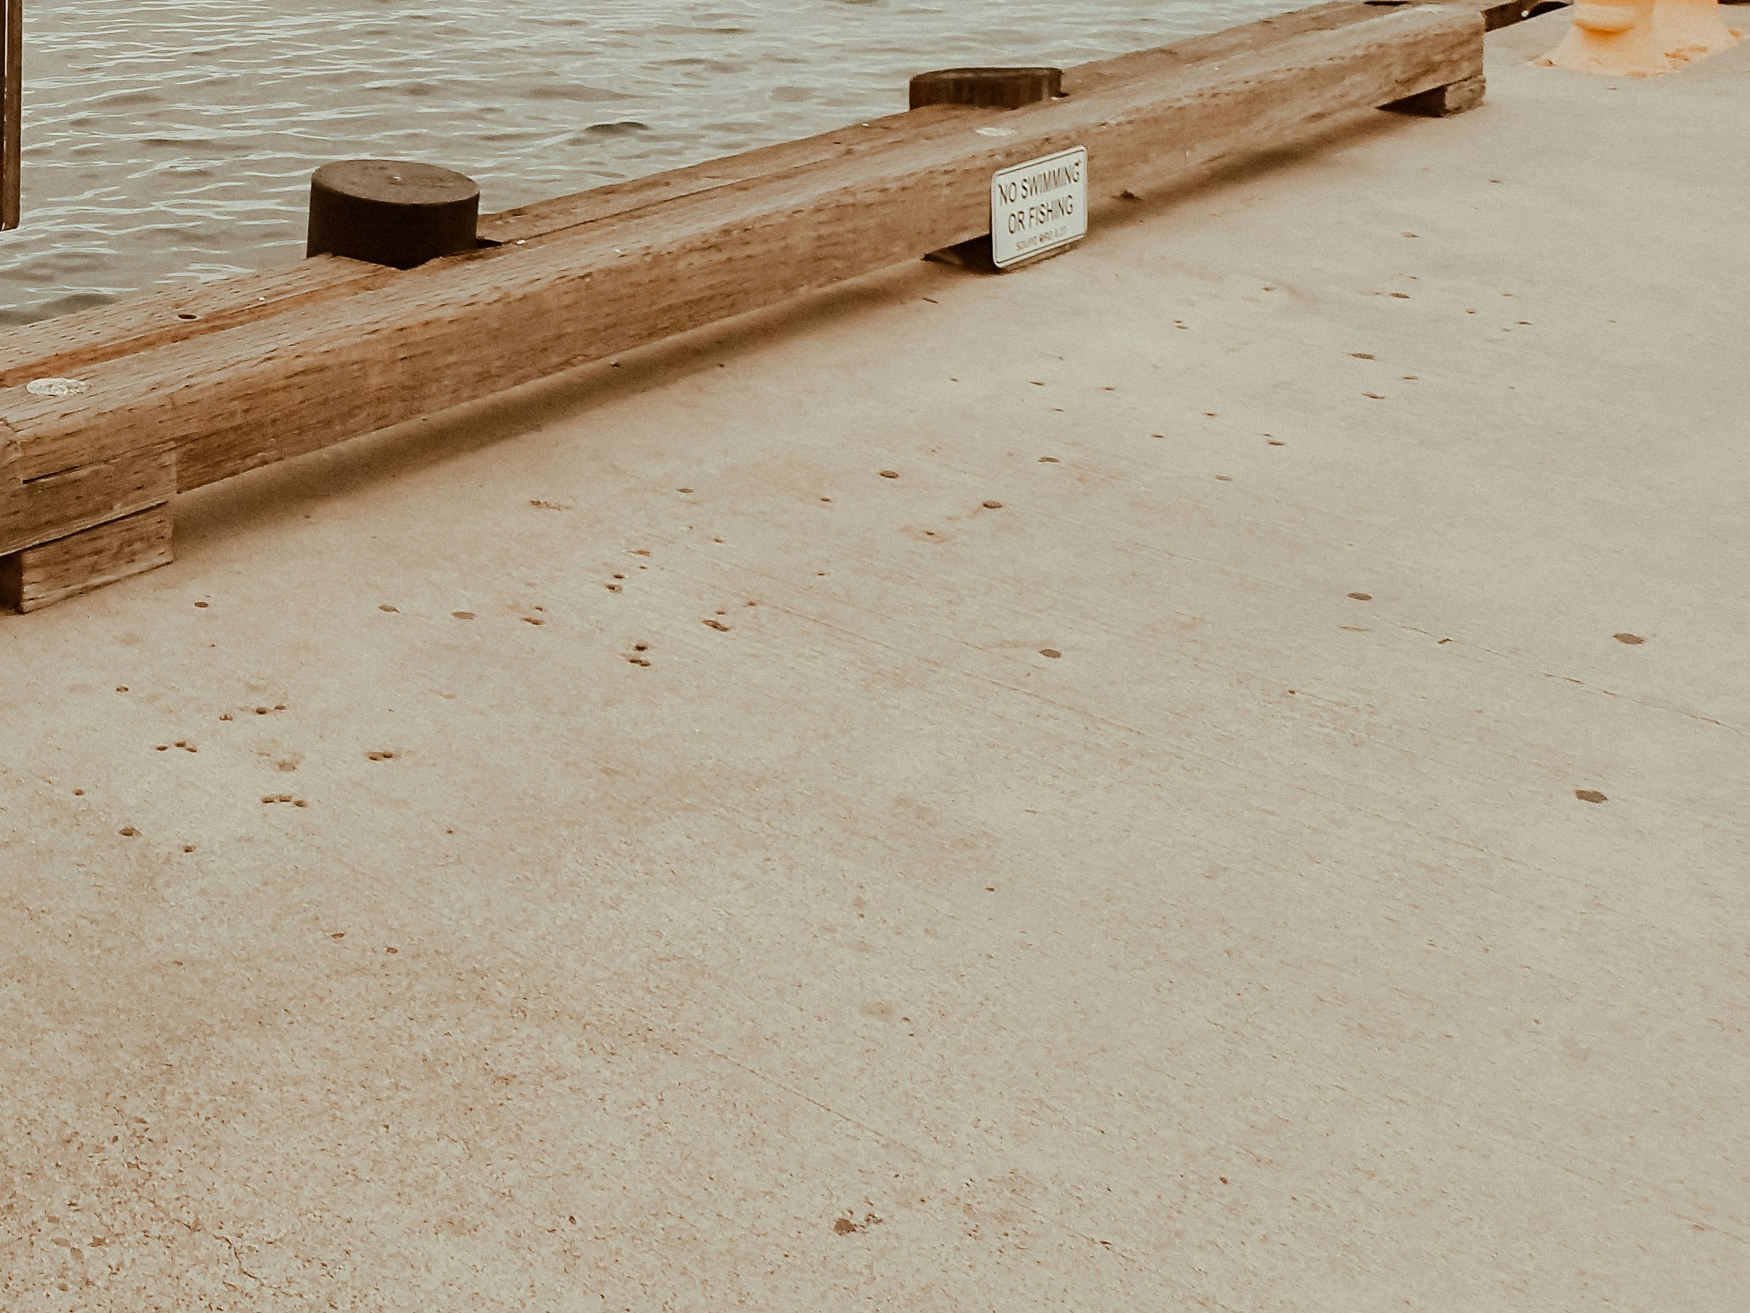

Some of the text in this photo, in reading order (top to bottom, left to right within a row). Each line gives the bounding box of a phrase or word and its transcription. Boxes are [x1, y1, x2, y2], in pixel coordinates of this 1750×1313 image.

[998, 161, 1081, 206] NO SWIMMING
[1008, 195, 1073, 234] OR FISHING
